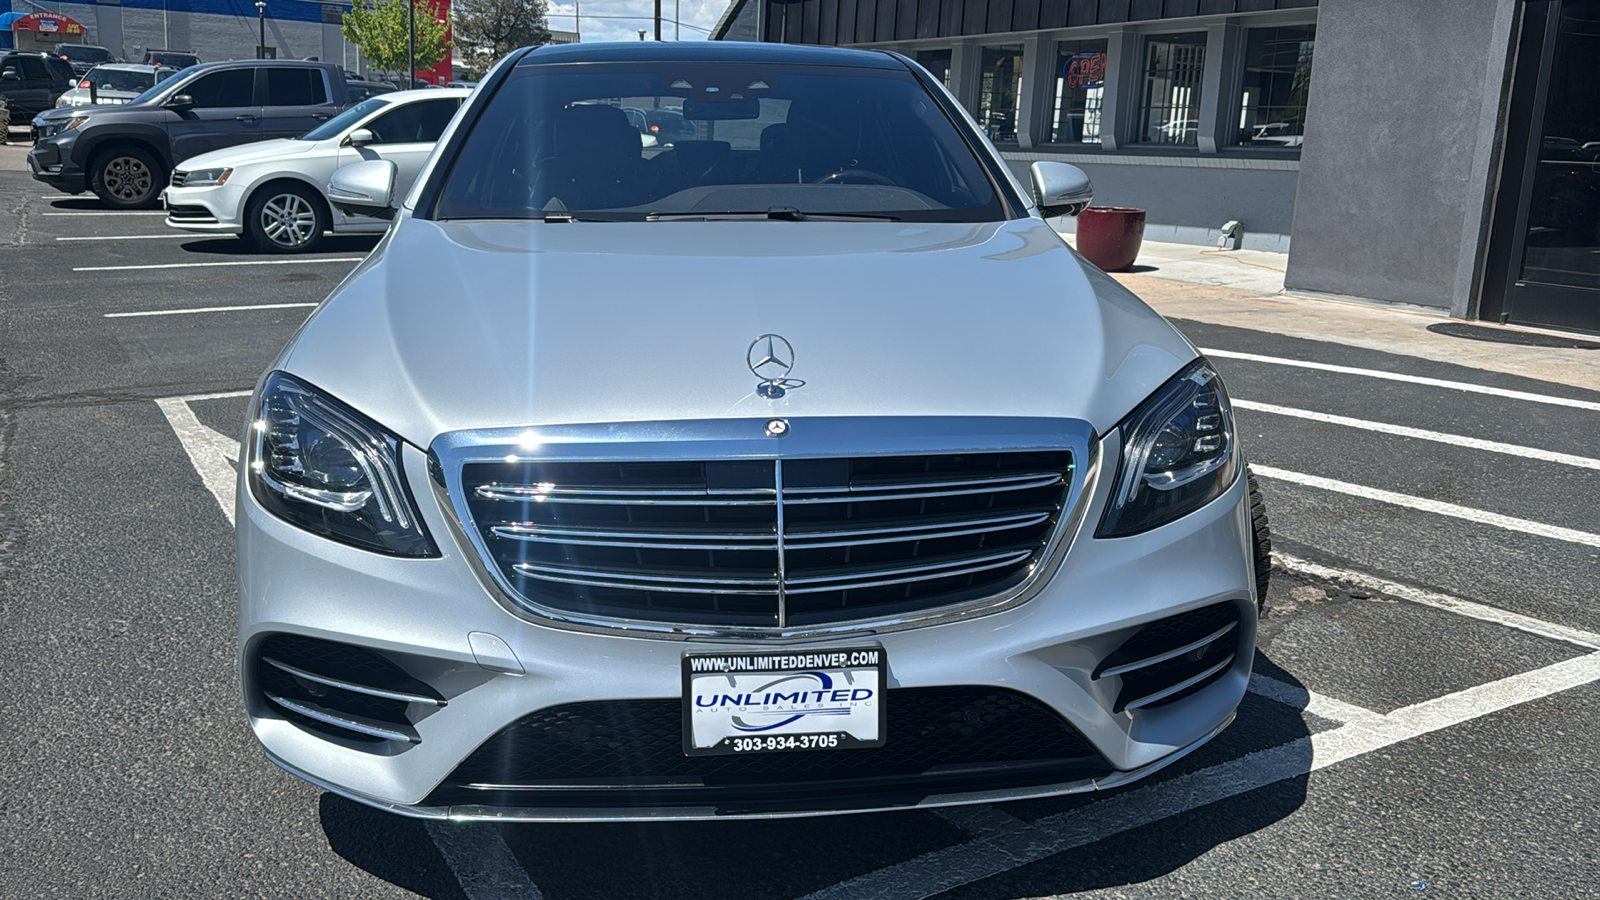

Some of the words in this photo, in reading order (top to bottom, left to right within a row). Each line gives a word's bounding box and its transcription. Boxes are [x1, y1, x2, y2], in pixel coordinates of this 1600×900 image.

[30, 13, 67, 21] ENTRANCE
[691, 651, 879, 672] WWWUNLIMITEDDENVER.COM
[696, 688, 873, 707] UNLIMITED
[762, 703, 824, 711] SALES
[733, 735, 838, 751] 303-934-3705
